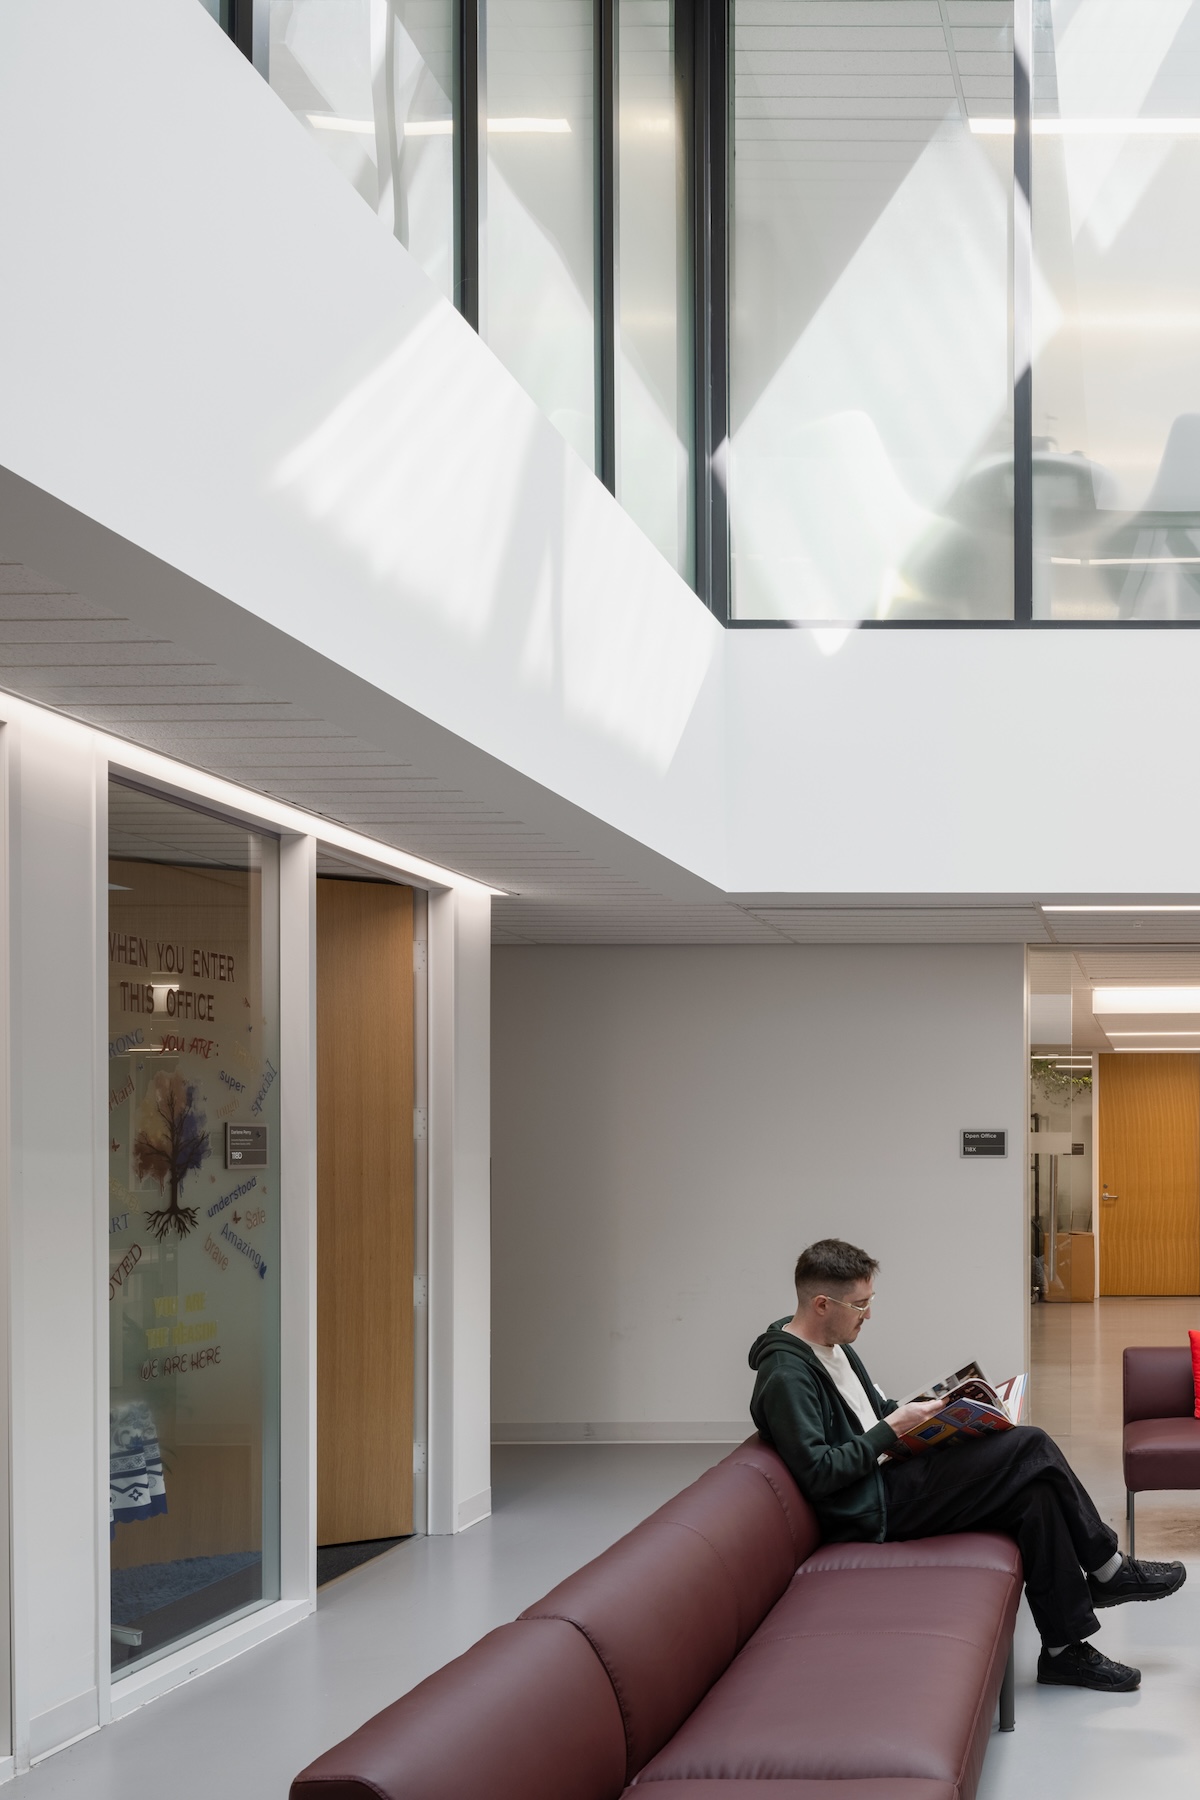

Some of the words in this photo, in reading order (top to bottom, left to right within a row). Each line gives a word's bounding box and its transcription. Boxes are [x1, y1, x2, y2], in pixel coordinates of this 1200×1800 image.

[155, 943, 185, 974] YOU
[193, 950, 235, 982] ENTER
[120, 981, 154, 1014] THIS
[166, 989, 215, 1022] OFFICE
[158, 1034, 185, 1056] YOU
[219, 1070, 246, 1094] super
[251, 1058, 279, 1117] special
[207, 1175, 258, 1218] understood
[203, 1232, 230, 1272] brave
[220, 1222, 263, 1270] Amazing
[153, 1295, 179, 1318] YOU
[185, 1292, 207, 1313] ARE
[145, 1327, 169, 1350] THE
[172, 1322, 219, 1347] REASON
[140, 1358, 159, 1381] WE
[163, 1353, 188, 1376] ARE
[191, 1345, 222, 1370] HERE
